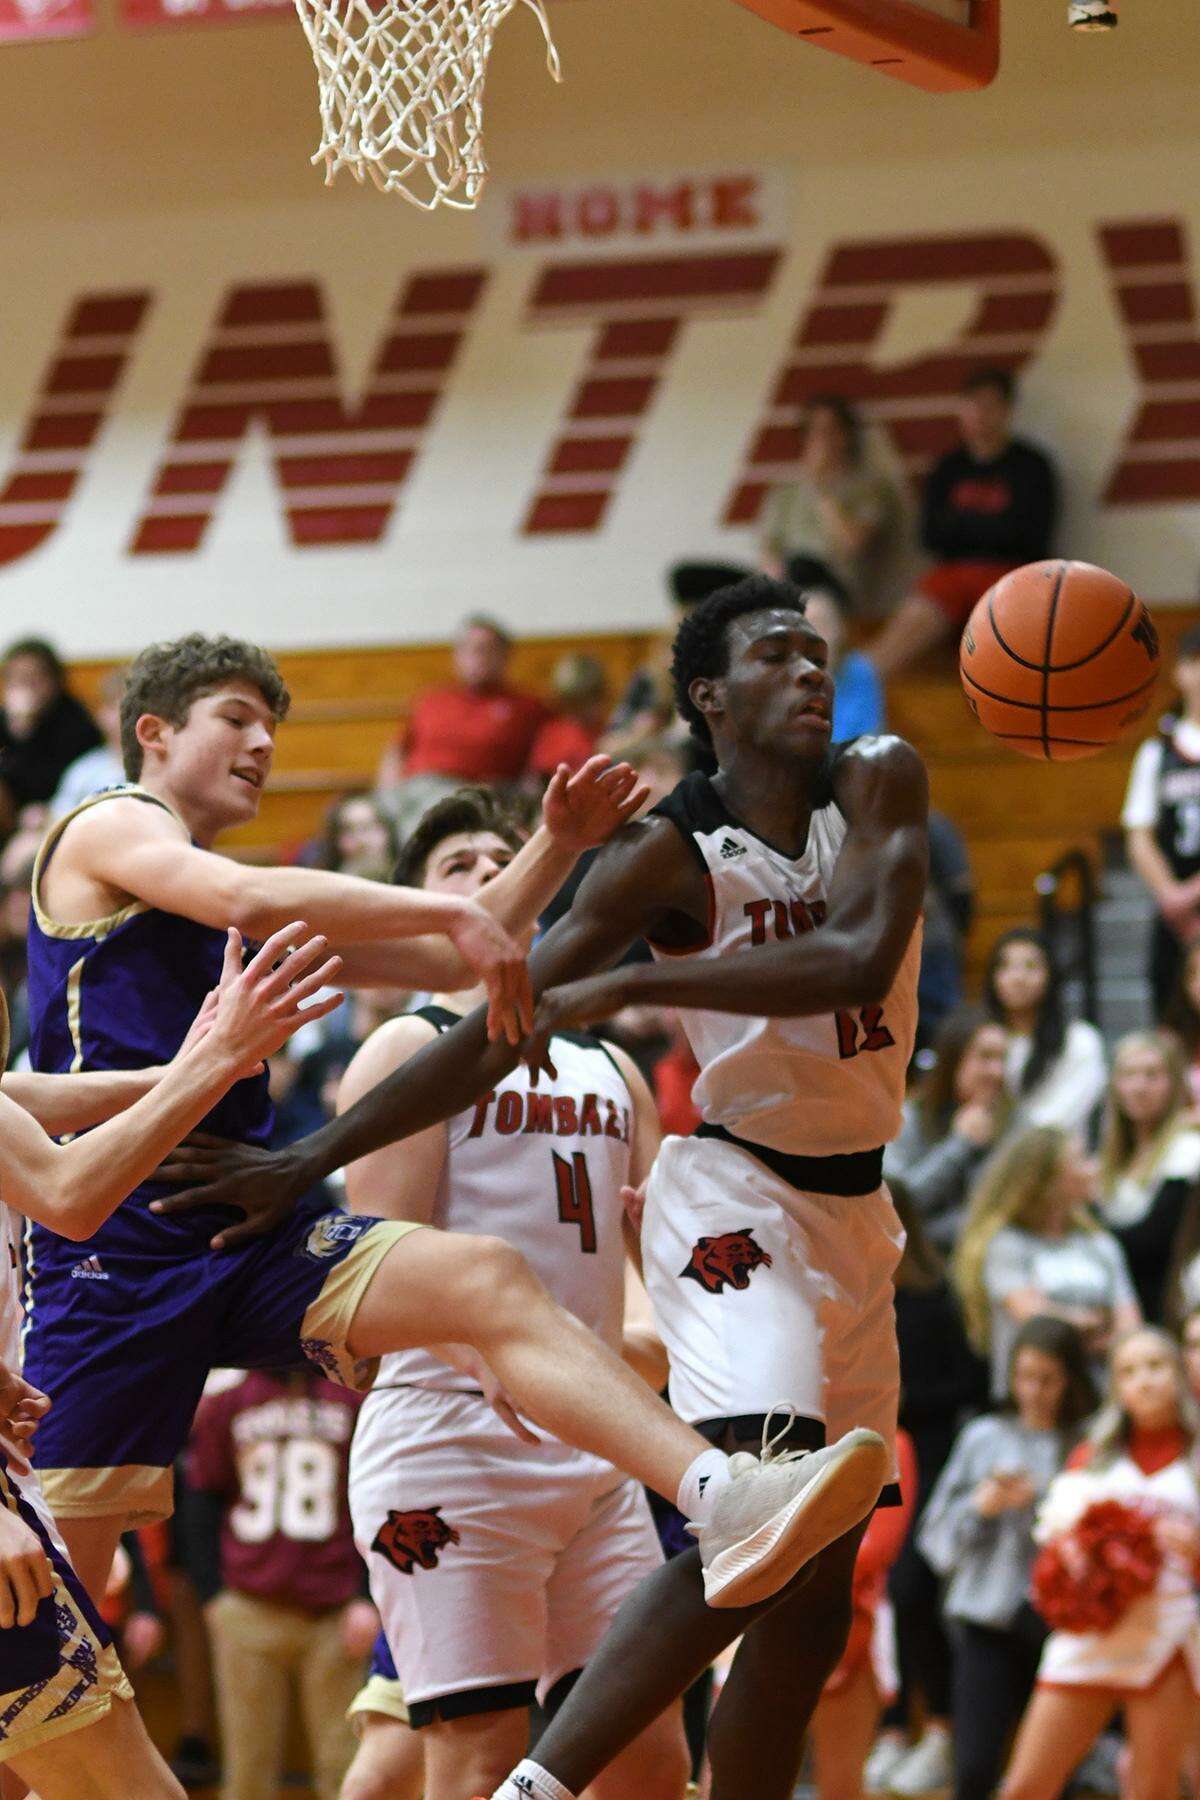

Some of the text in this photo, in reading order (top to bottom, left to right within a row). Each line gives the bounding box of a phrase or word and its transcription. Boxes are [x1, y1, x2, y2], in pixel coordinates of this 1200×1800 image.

[512, 174, 758, 244] HOME
[551, 1148, 598, 1254] 4
[71, 1269, 110, 1280] adidas
[230, 1438, 339, 1542] 98
